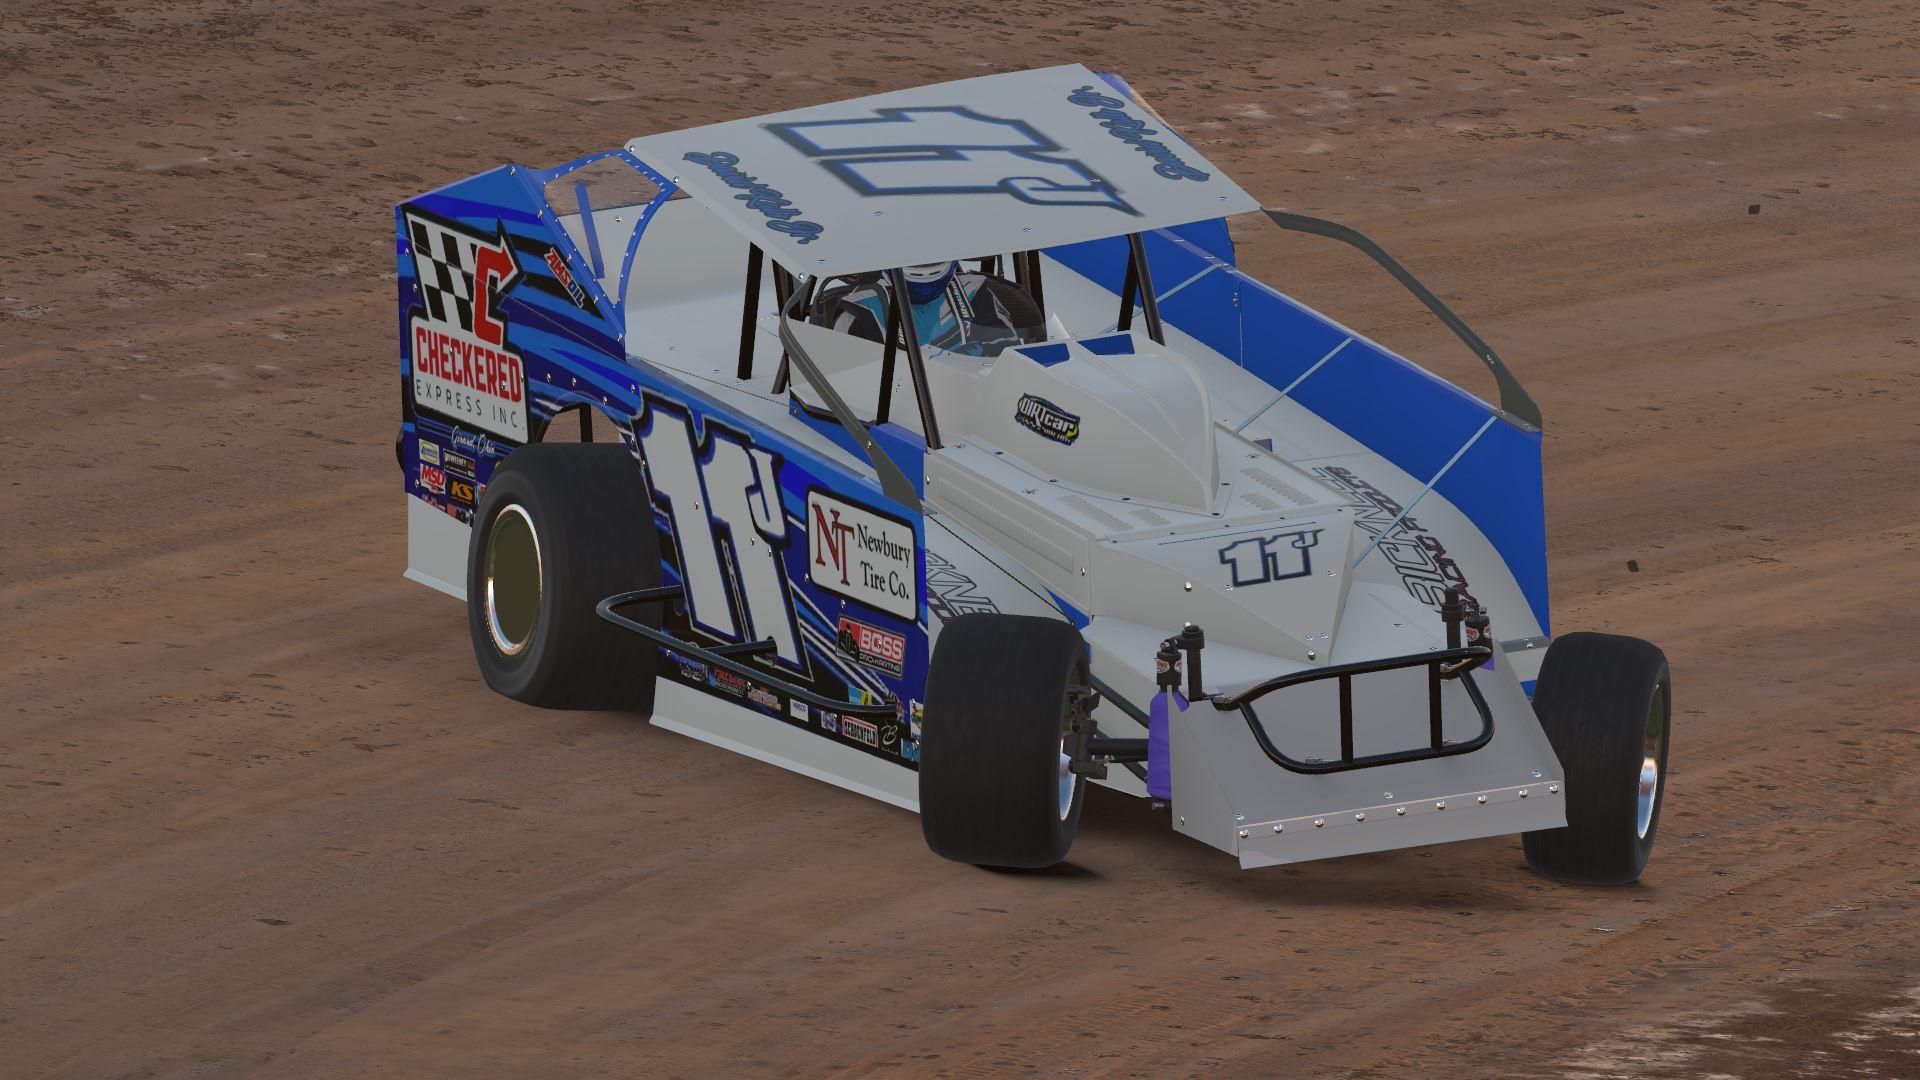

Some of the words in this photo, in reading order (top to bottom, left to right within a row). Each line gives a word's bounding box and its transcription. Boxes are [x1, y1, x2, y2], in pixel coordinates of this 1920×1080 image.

[544, 247, 585, 308] AMSOIL
[415, 326, 522, 404] CHECKERED
[415, 379, 483, 417] EXPRESS
[492, 407, 518, 428] INC
[421, 464, 447, 487] MSD
[812, 504, 855, 586] NT
[857, 523, 911, 569] Newbury
[860, 561, 886, 592] Tire
[888, 572, 910, 600] Co.
[860, 628, 903, 660] BOSS
